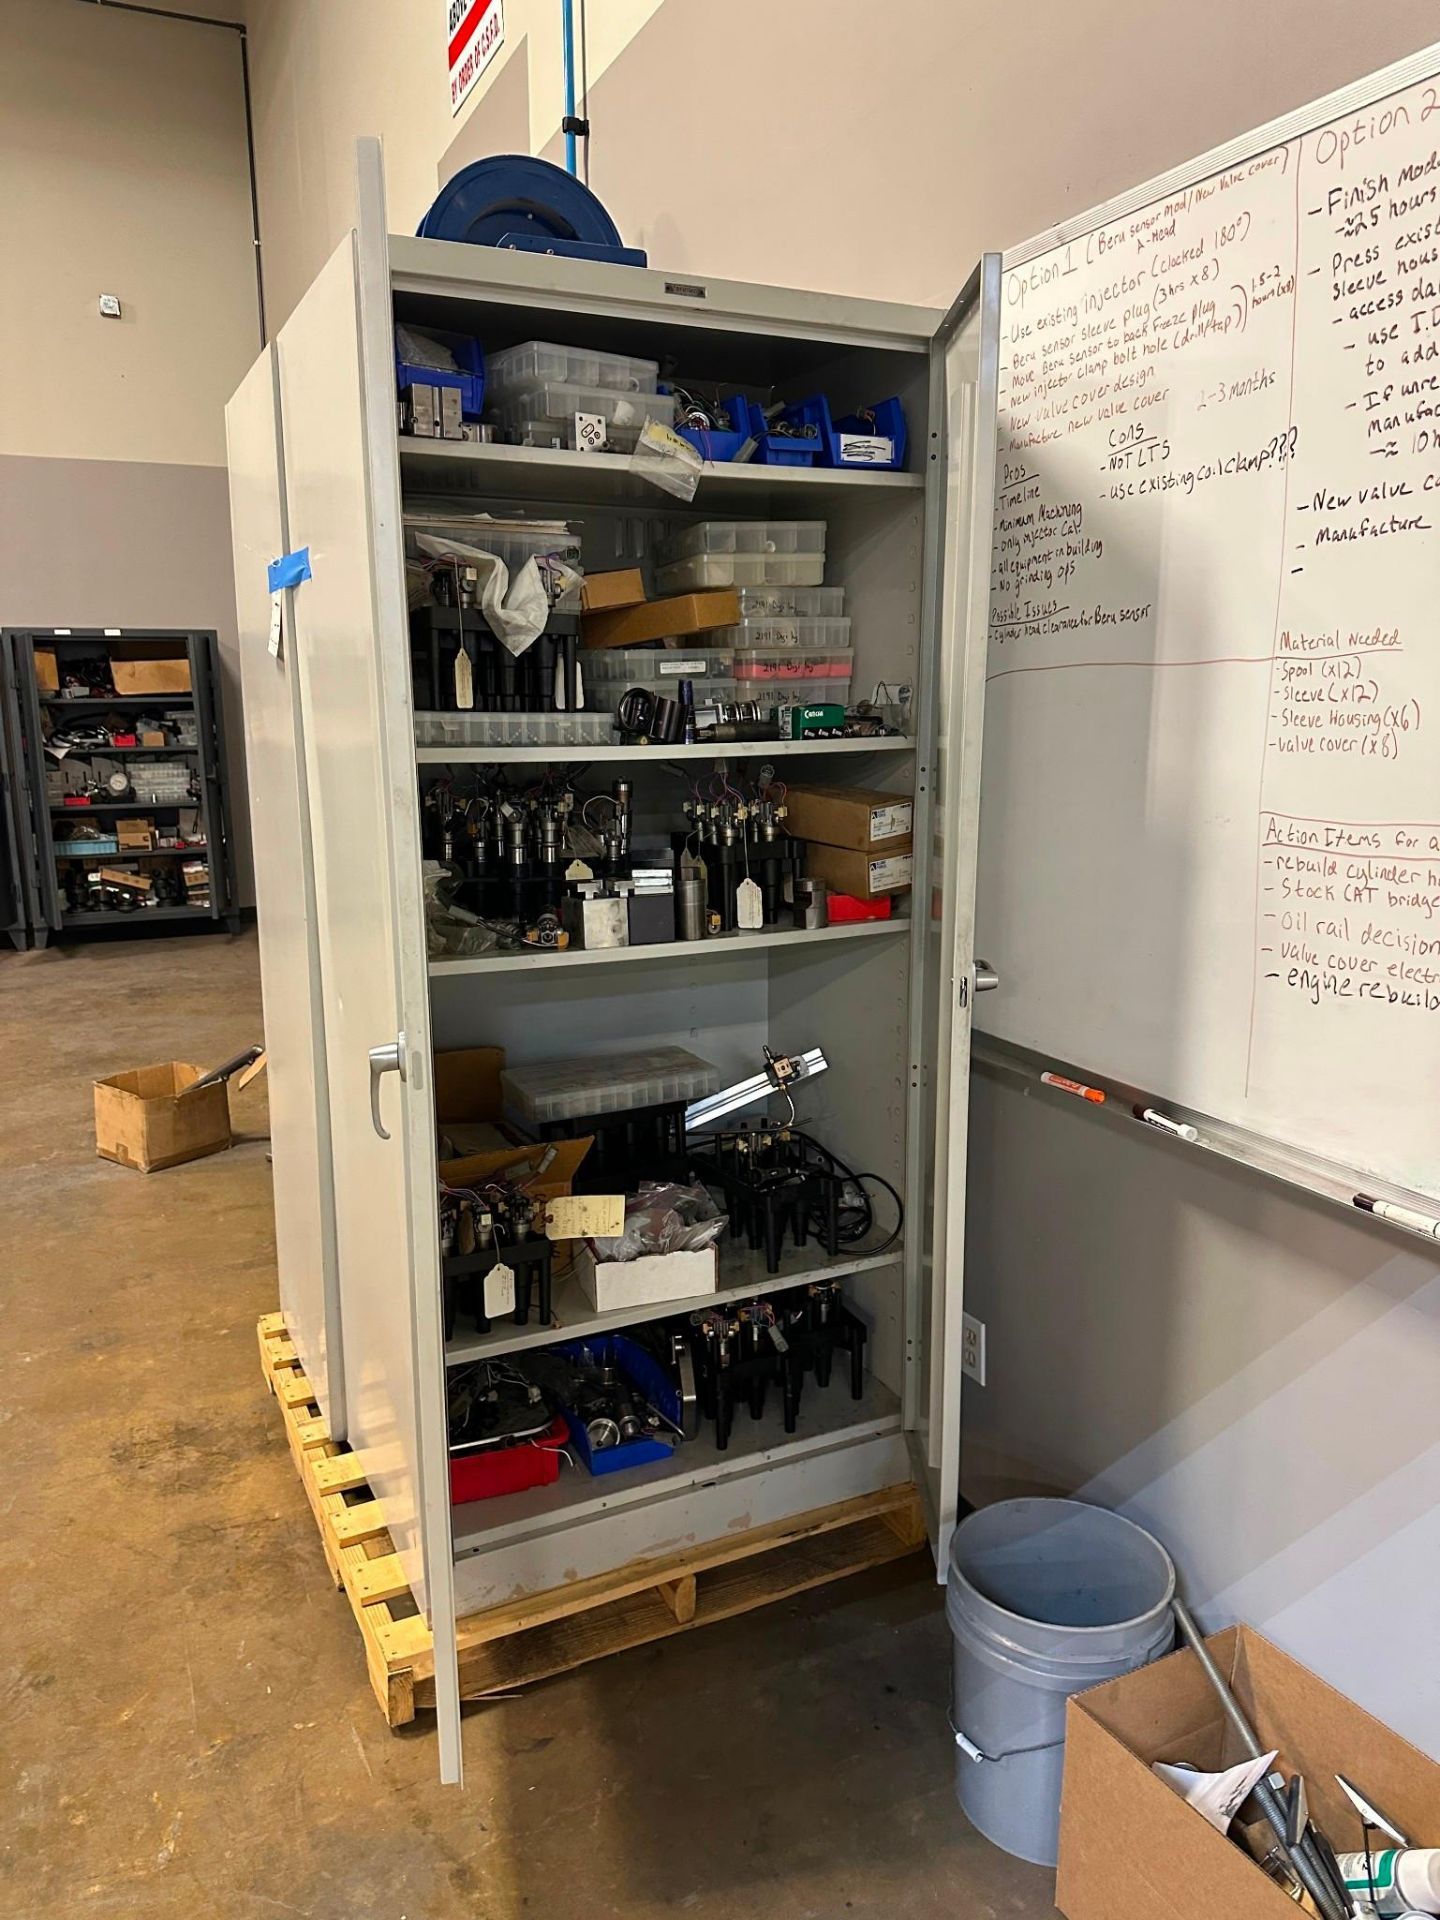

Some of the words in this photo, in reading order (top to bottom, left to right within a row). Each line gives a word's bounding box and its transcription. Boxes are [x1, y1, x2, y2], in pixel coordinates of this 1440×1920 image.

[1316, 106, 1410, 170] Option
[1421, 88, 1440, 122] 2
[1390, 186, 1437, 219] hours
[1008, 263, 1059, 309] Option
[1062, 246, 1078, 276] 1
[1130, 212, 1161, 238] sensor
[1332, 245, 1380, 278] Press
[1037, 305, 1078, 328] existing
[1084, 271, 1146, 315] injector
[1350, 289, 1404, 320] access
[1412, 277, 1440, 302] da
[1042, 334, 1076, 357] sensor
[1081, 319, 1117, 341] sleeve
[1123, 303, 1151, 327] plug
[1070, 342, 1103, 365] sensor
[1108, 338, 1120, 349] to
[1124, 323, 1148, 344] back
[1368, 324, 1399, 345] use
[1034, 373, 1072, 399] injector
[1113, 346, 1137, 365] bolt
[1143, 337, 1168, 355] hole
[1365, 353, 1385, 377] to
[1401, 341, 1439, 364] add
[1073, 384, 1110, 409] cover
[1113, 366, 1154, 392] design
[1363, 384, 1394, 412] If
[1098, 402, 1128, 421] valve
[1134, 388, 1169, 411] cover
[1109, 422, 1145, 448] Cons
[1003, 464, 1026, 484] Pros
[1138, 467, 1195, 495] existing
[1313, 488, 1351, 511] New
[1023, 526, 1057, 548] injector
[1010, 550, 1053, 577] equipment
[1066, 538, 1103, 559] building
[1015, 569, 1052, 599] grinding
[992, 602, 1021, 623] Possible
[1024, 600, 1057, 618] Issues
[1119, 603, 1152, 623] sensor
[1280, 629, 1341, 651] Material
[1349, 627, 1402, 647] Needed
[1281, 661, 1313, 682] Spool
[1329, 708, 1381, 736] Housing
[1319, 736, 1358, 753] cover
[1266, 816, 1319, 845] Action
[1325, 827, 1381, 849] Items
[1396, 830, 1419, 848] for
[1276, 856, 1337, 878] rebuild
[1344, 883, 1379, 904] CAT
[1316, 918, 1350, 941] rail
[1327, 953, 1378, 973] cover
[1288, 967, 1354, 1005] engine
